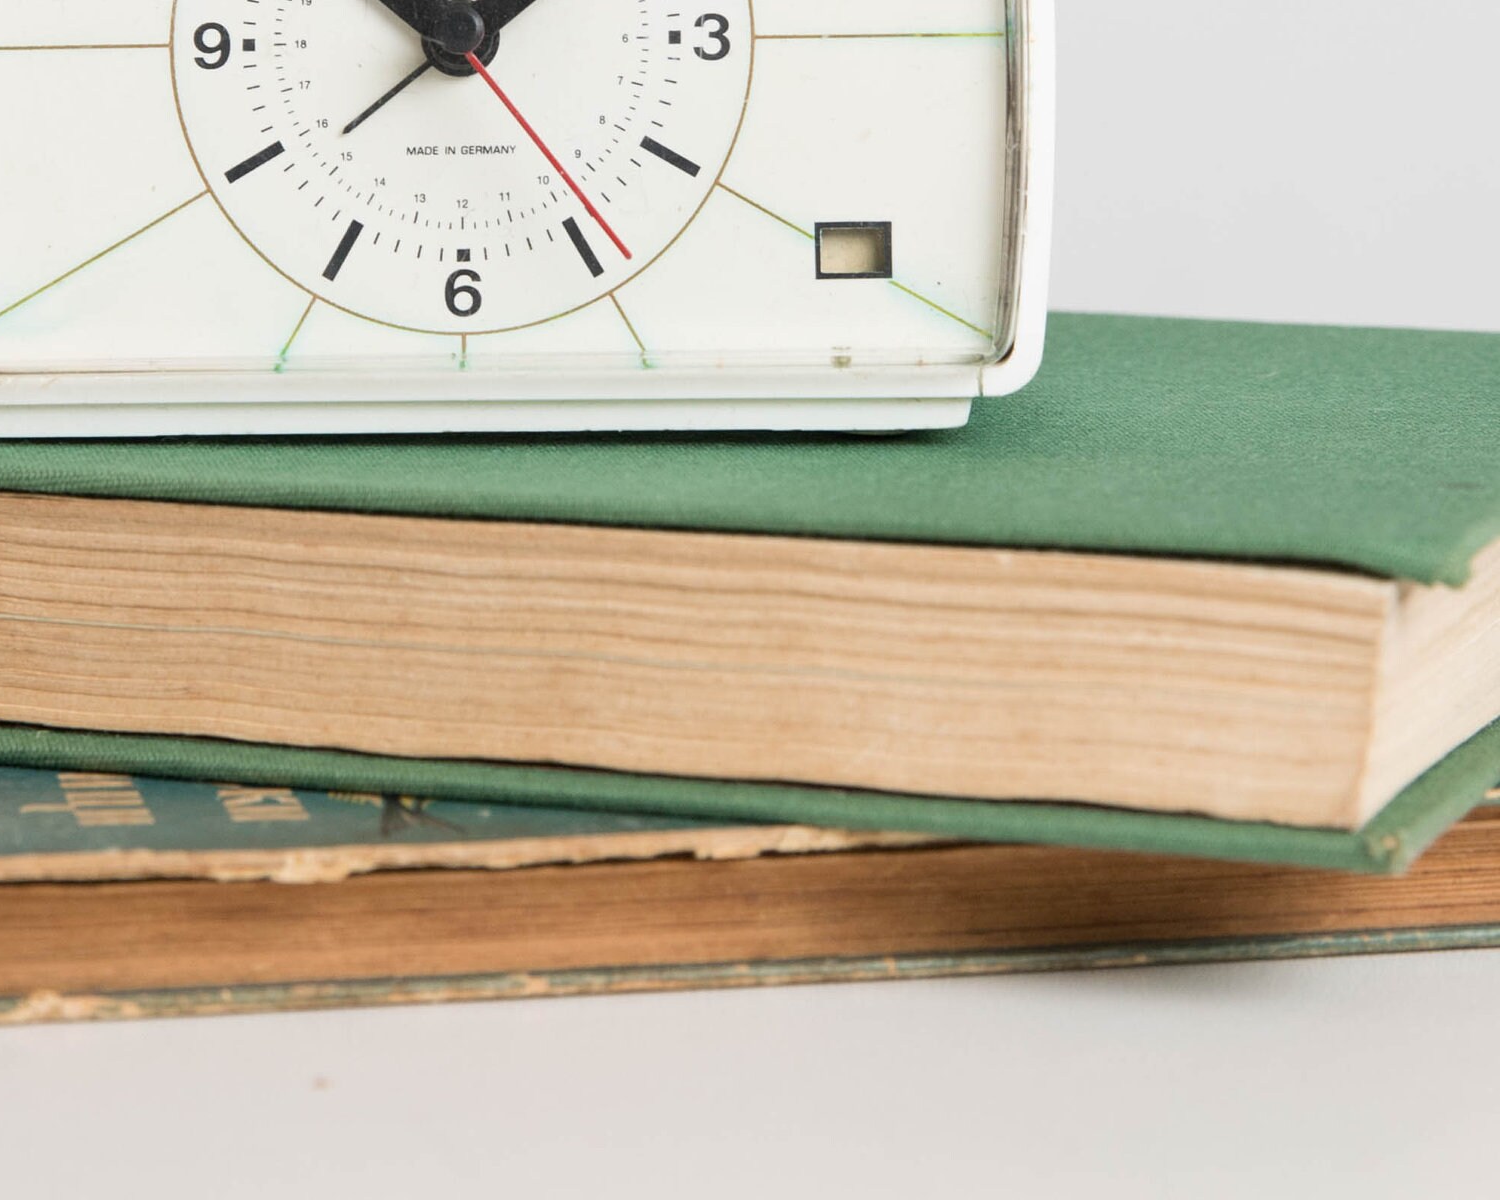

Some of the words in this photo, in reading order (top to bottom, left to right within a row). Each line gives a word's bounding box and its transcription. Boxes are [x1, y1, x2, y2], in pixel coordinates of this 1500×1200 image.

[621, 33, 629, 44] 6
[694, 14, 730, 60] 3
[194, 23, 230, 69] 9
[295, 39, 307, 49] 18
[299, 80, 311, 90] 17
[617, 75, 624, 85] 7
[316, 118, 329, 129] 16
[599, 115, 606, 125] 8
[406, 145, 439, 156] MADE
[445, 146, 456, 155] IN
[461, 145, 516, 156] GERMANY
[574, 148, 582, 159] 9
[340, 151, 353, 162] 15
[374, 177, 386, 186] 14
[537, 175, 550, 185] 10
[414, 193, 426, 204] 13
[499, 191, 510, 201] 11
[456, 198, 469, 209] 12
[445, 269, 481, 317] 6
